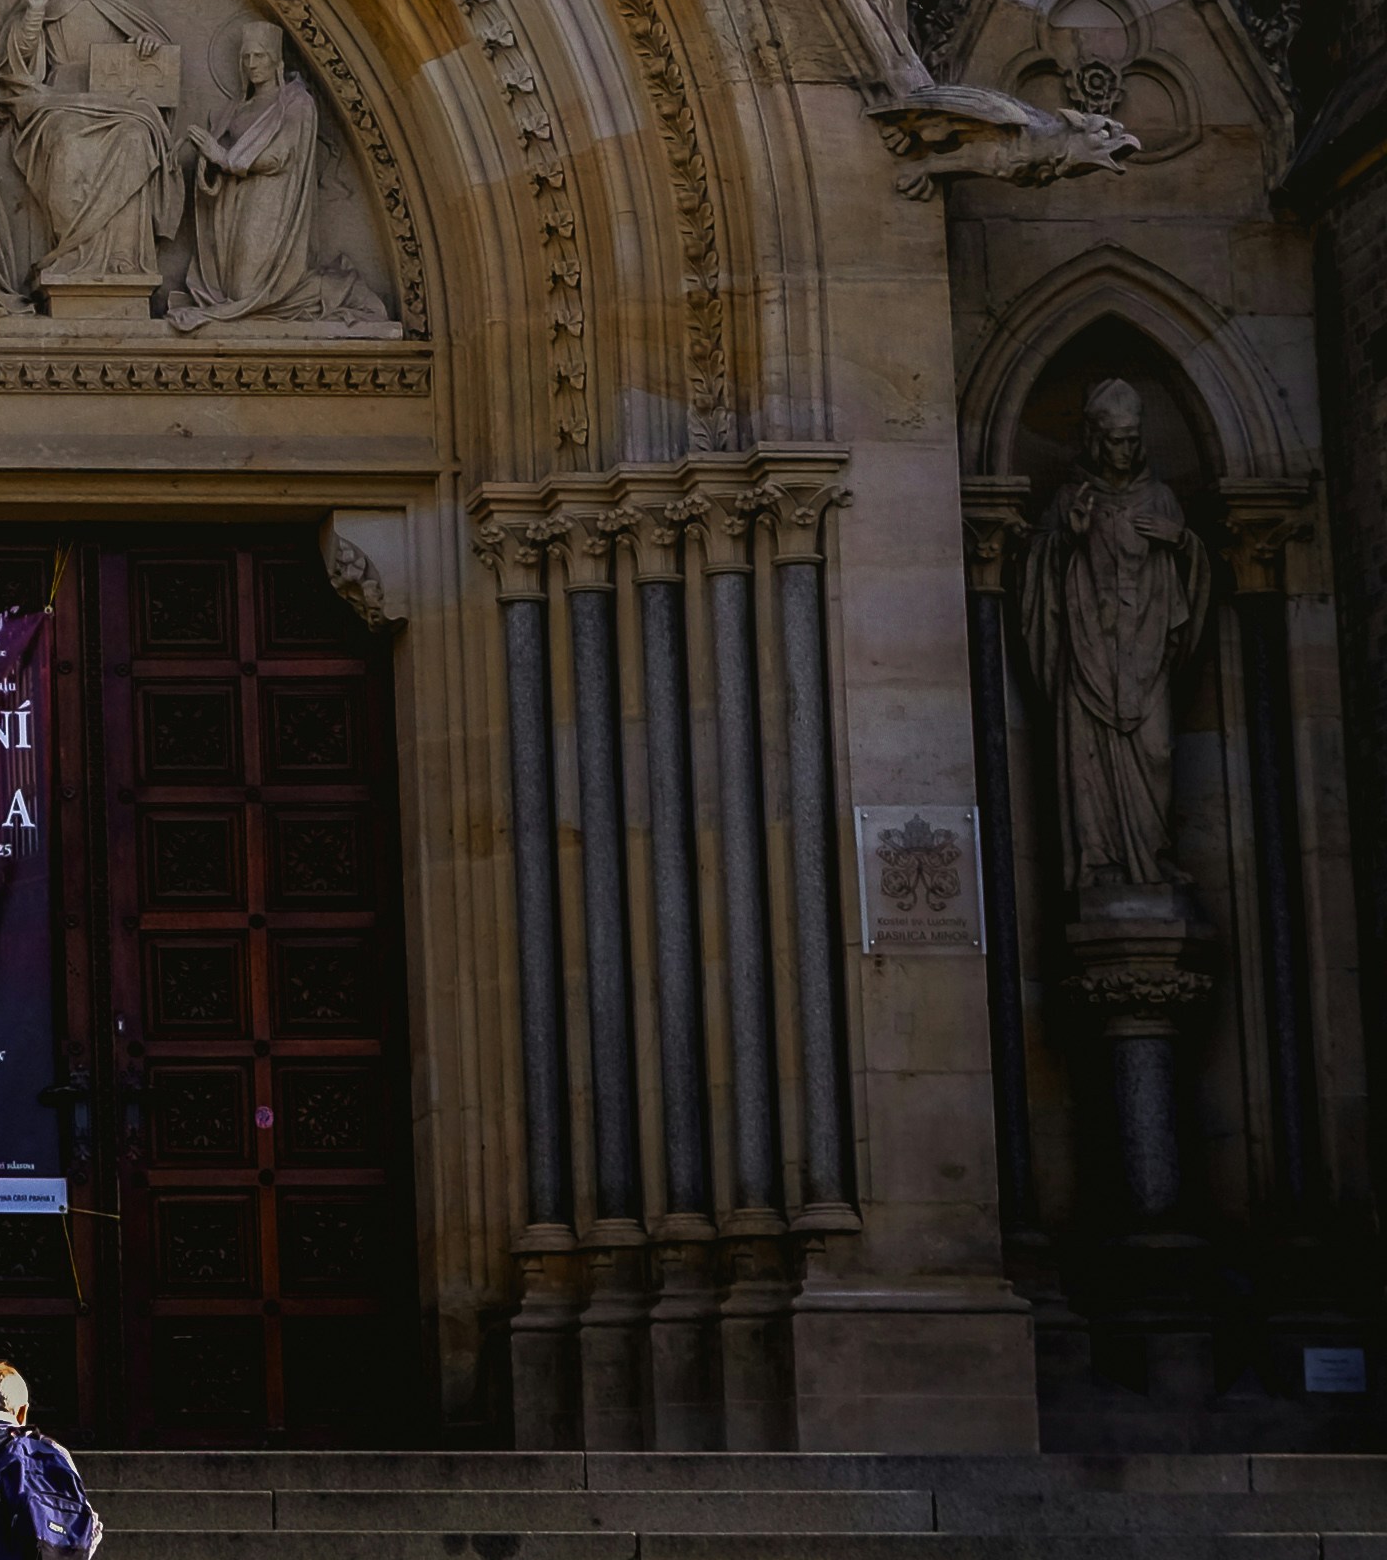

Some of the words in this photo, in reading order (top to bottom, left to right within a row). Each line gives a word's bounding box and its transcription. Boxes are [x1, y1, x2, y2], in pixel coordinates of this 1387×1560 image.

[877, 916, 909, 926] Kostel
[877, 930, 927, 941] BASILICA
[930, 930, 969, 941] MINOR
